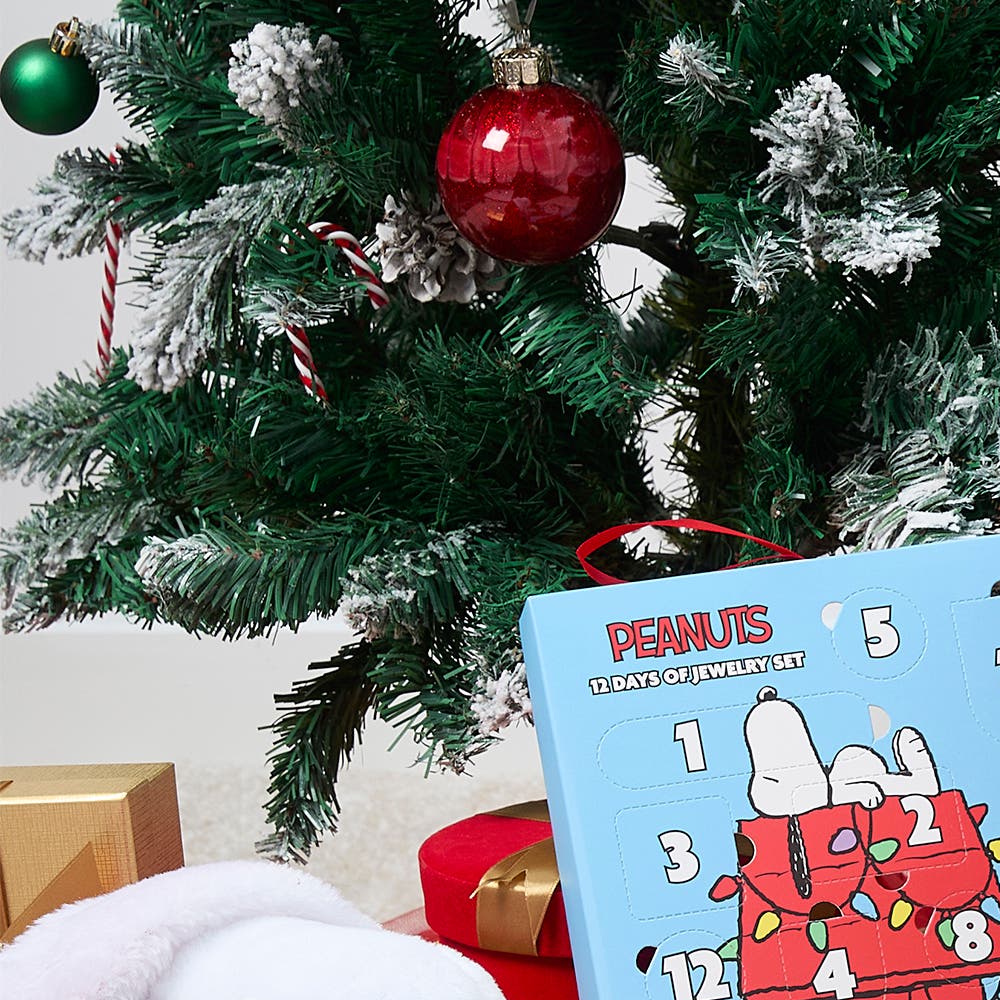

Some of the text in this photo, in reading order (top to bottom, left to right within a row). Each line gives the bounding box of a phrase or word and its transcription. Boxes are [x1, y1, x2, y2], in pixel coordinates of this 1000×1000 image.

[606, 604, 774, 663] PEANUTS
[860, 604, 901, 659] 5
[588, 650, 806, 696] 12 DAYS OF JEWELRY SET
[673, 718, 708, 774] 1
[899, 794, 944, 848] 2
[656, 829, 701, 885] 3
[950, 908, 995, 963] 8
[811, 946, 858, 1000] 4
